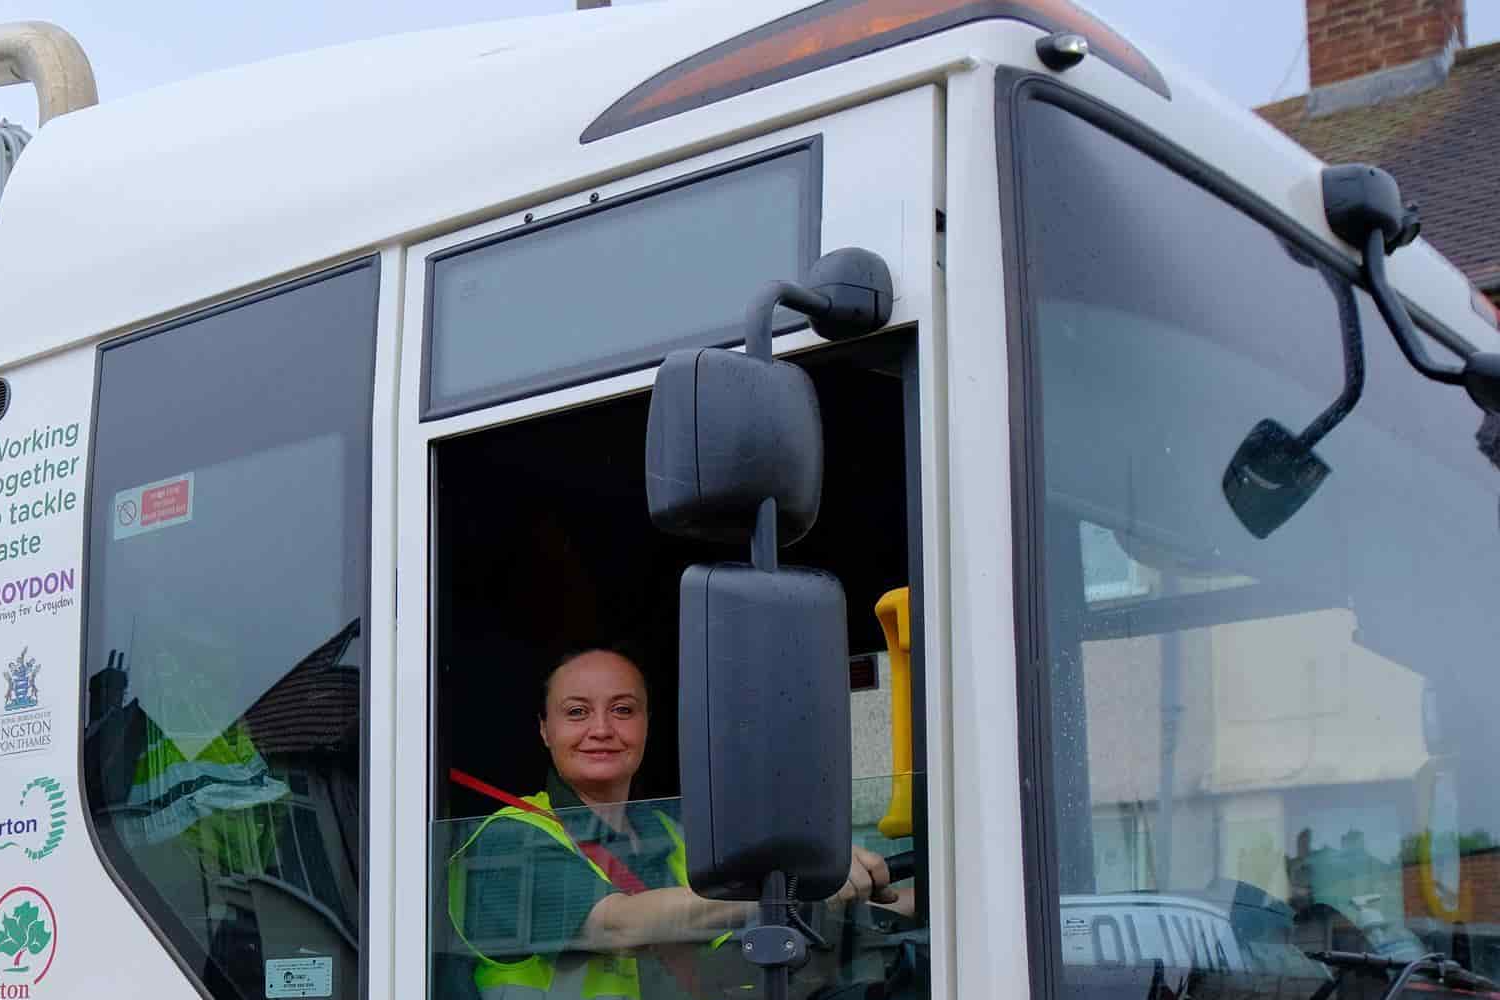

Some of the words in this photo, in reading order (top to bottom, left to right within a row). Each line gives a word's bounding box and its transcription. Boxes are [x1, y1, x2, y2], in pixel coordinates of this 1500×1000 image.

[9, 488, 77, 525] tackle
[19, 602, 31, 617] for
[35, 596, 74, 615] Croydon
[17, 735, 52, 749] THAMES
